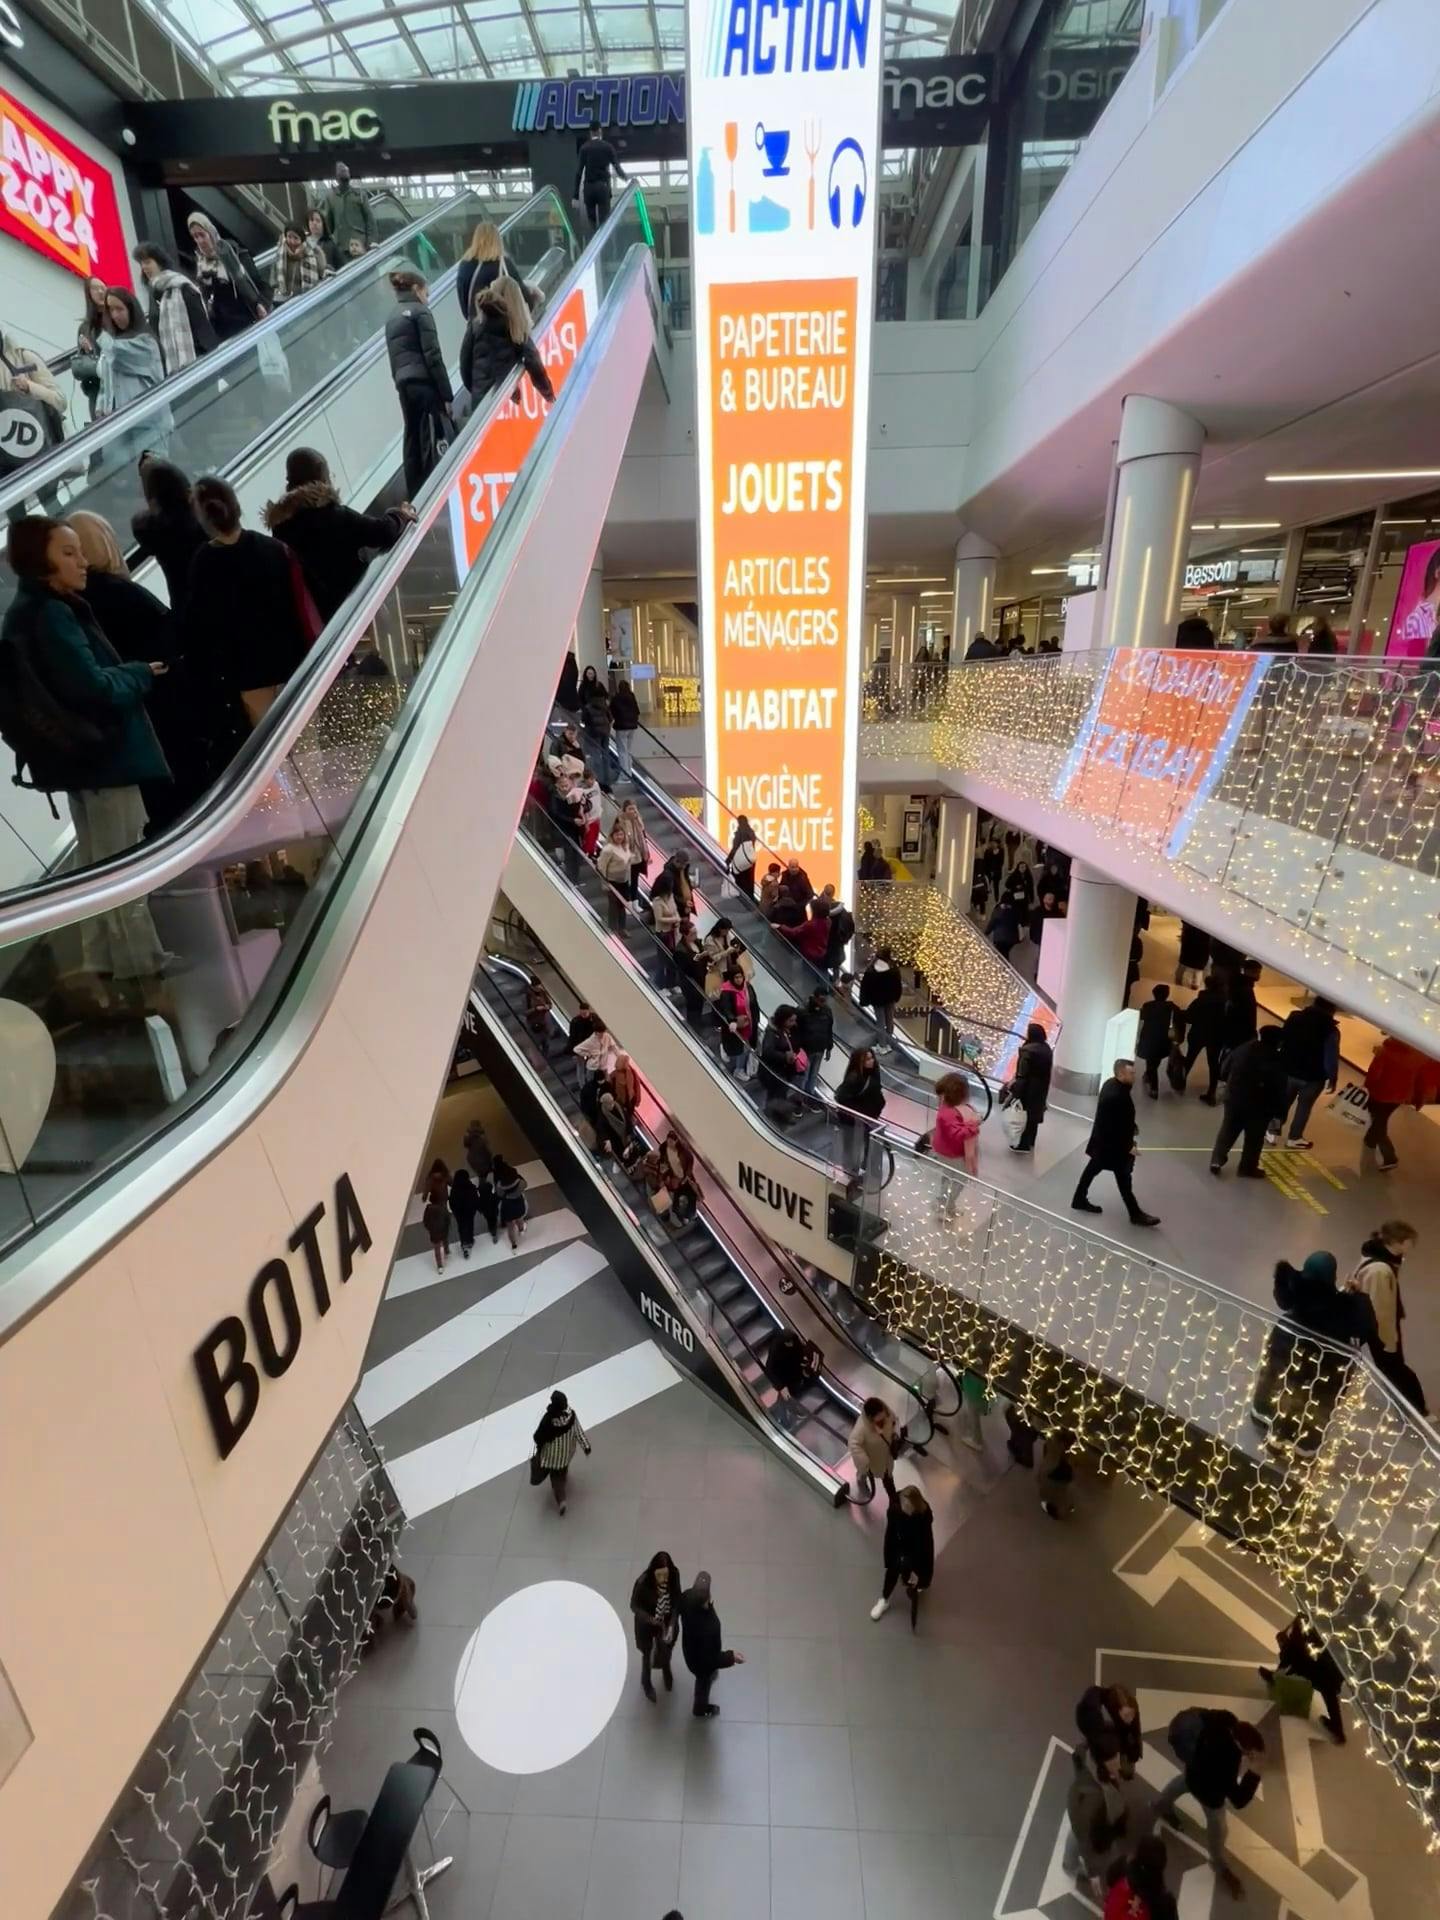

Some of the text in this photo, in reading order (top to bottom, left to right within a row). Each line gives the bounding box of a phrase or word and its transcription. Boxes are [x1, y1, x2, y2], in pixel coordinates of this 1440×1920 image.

[723, 0, 871, 77] ACTION
[268, 100, 380, 144] fnac
[535, 75, 687, 131] ACTION
[0, 113, 95, 219] APPY
[0, 161, 99, 264] 2024
[719, 310, 847, 359] PAPETERIE
[720, 365, 847, 412] & BUREAU
[1, 420, 38, 446] JD
[722, 459, 843, 515] JOUETS
[723, 556, 831, 597] ARTICLES
[1185, 561, 1231, 586] Besson
[724, 601, 839, 649] MÉNAGERS
[724, 688, 838, 731] HABITAT
[726, 764, 822, 811] HYGIÈNE
[738, 1161, 813, 1231] NEUVE
[193, 1172, 373, 1462] BOTA
[640, 1291, 694, 1353] METRO
